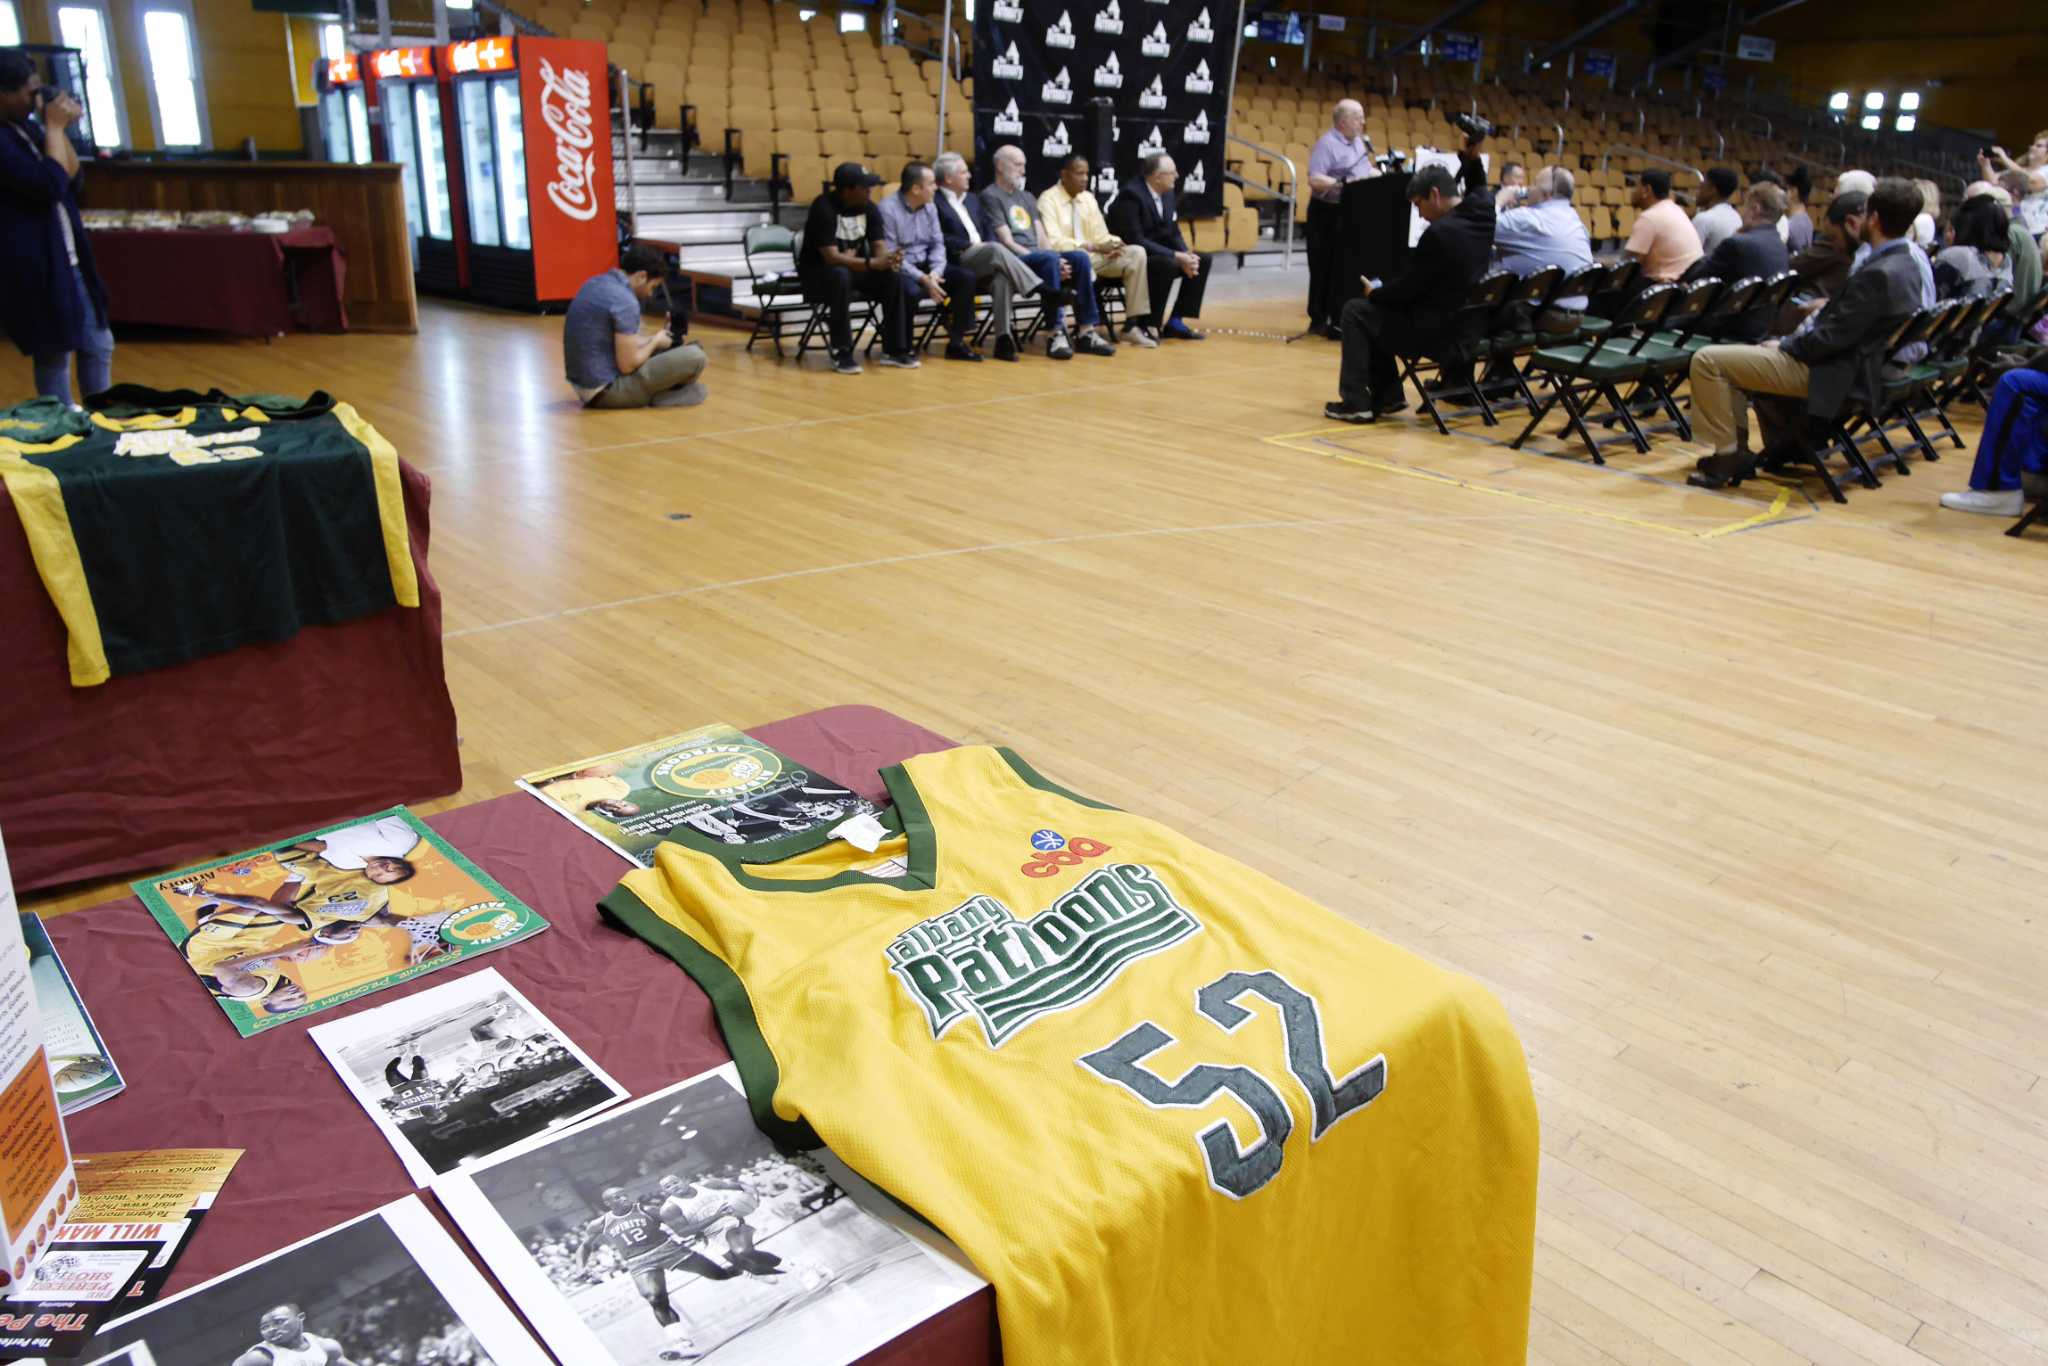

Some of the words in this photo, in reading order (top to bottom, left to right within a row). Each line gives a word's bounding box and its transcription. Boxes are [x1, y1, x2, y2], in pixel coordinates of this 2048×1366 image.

[539, 56, 599, 221] Coca-Cola
[1021, 836, 1113, 878] cba
[893, 896, 1010, 962] albany
[896, 864, 1164, 1036] Patroons
[1075, 979, 1388, 1201] 52
[110, 1223, 163, 1240] WILL
[609, 1217, 648, 1238] SPIRITS
[621, 1227, 648, 1246] 12
[34, 1313, 89, 1331] The
[32, 1337, 54, 1348] The
